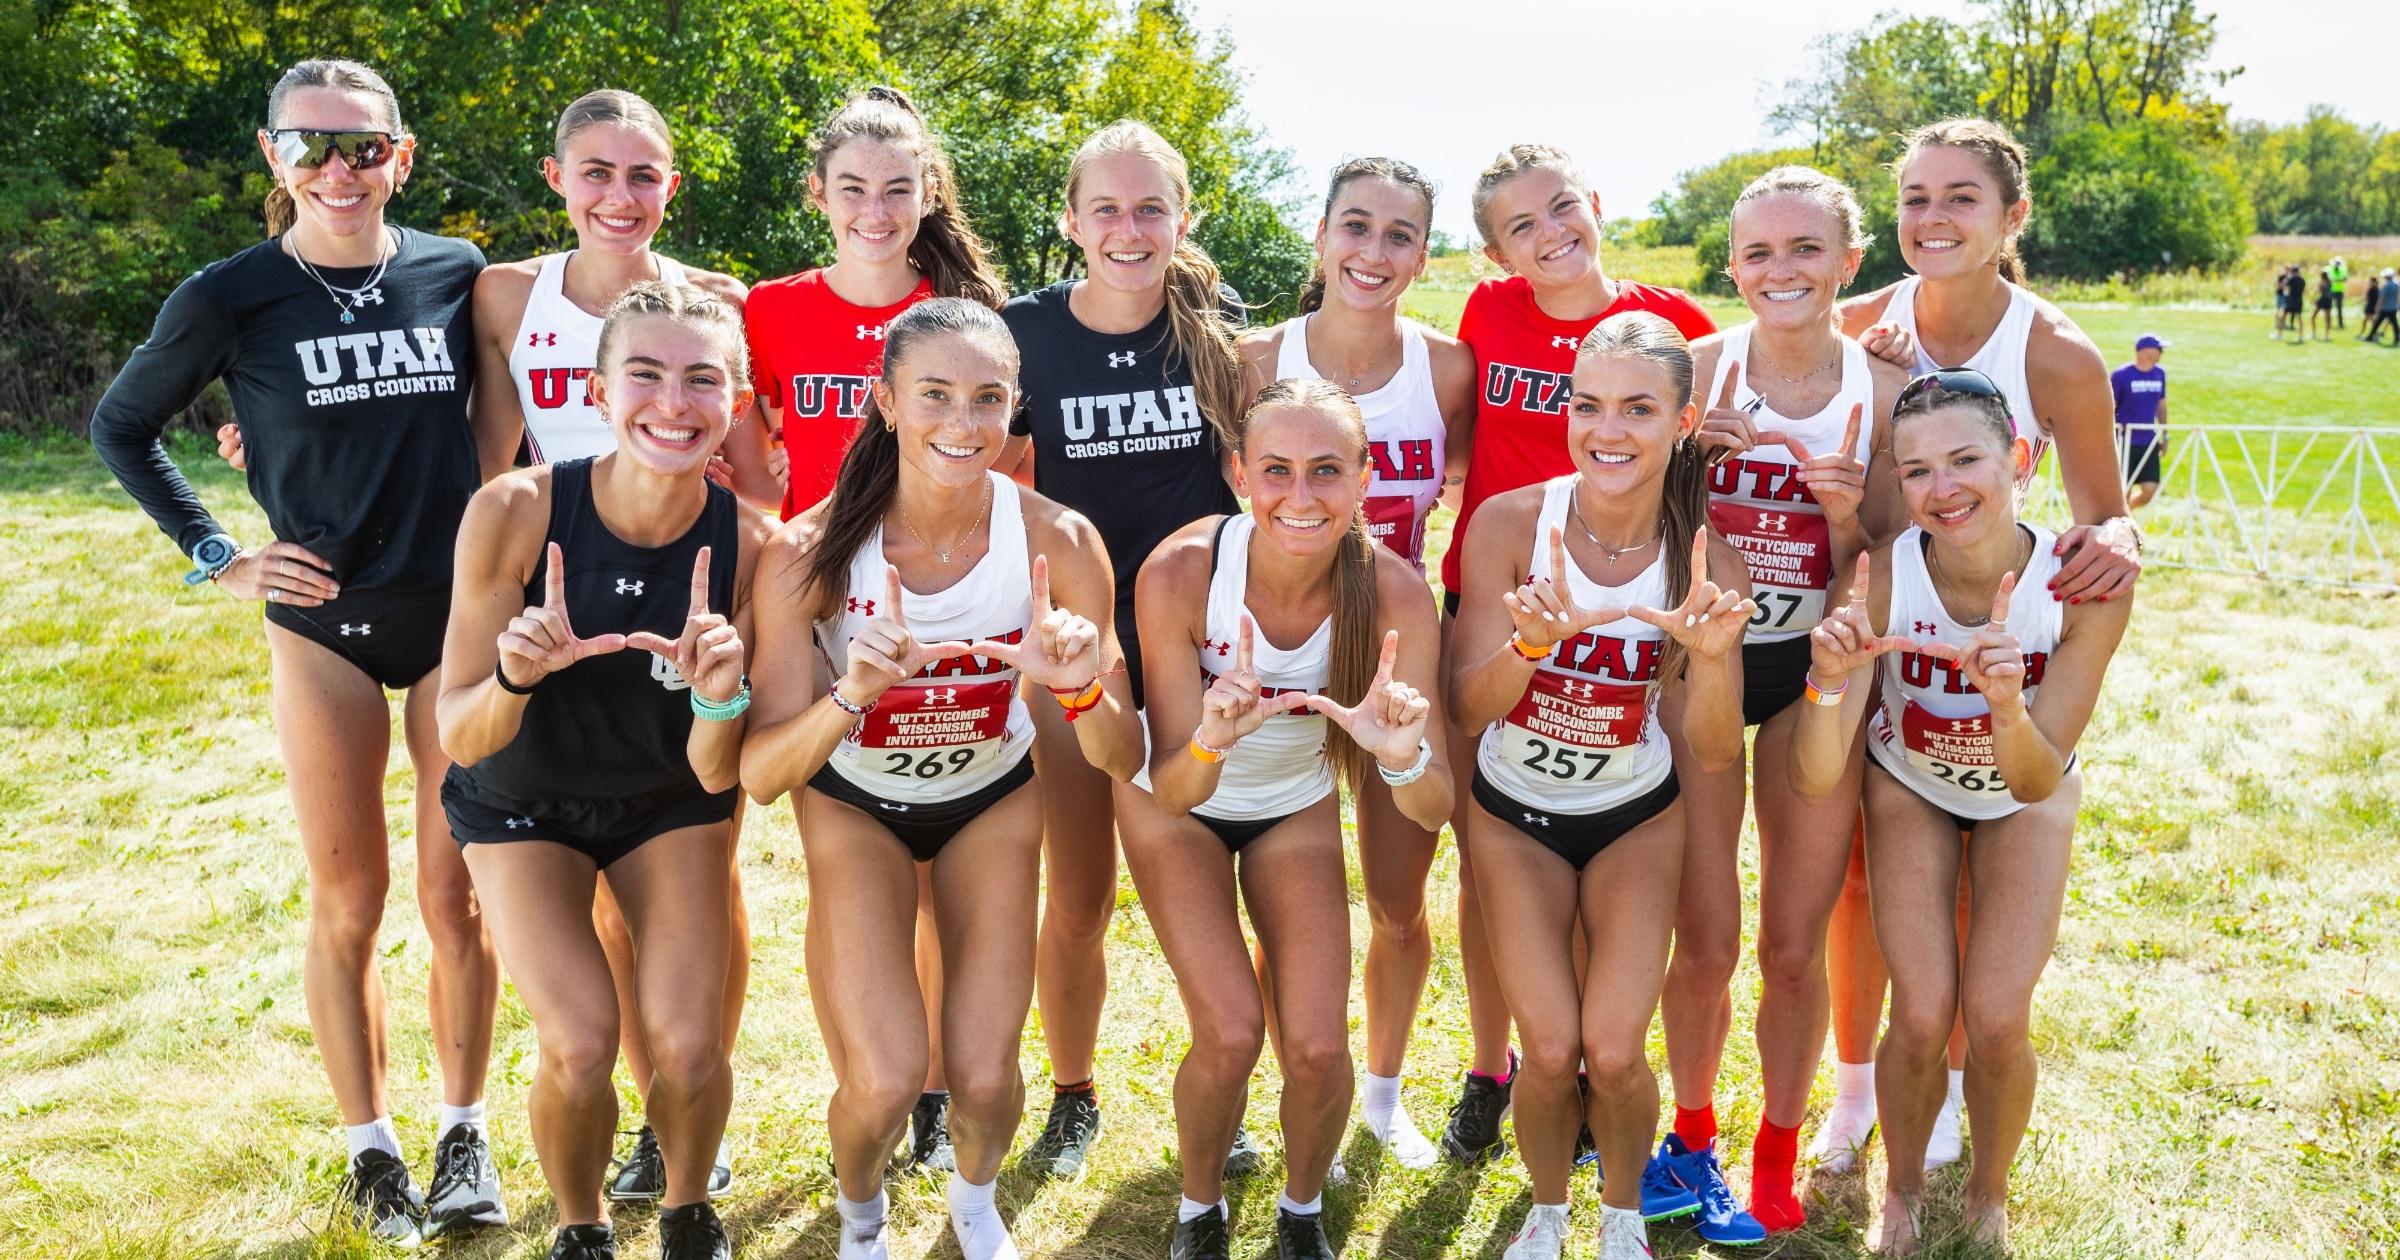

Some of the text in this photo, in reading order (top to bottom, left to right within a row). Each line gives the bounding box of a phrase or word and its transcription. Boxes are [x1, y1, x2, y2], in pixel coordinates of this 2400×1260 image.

[295, 327, 454, 386] UTAH
[306, 375, 456, 406] CROSS COUNTRY
[793, 374, 883, 418] UT
[1486, 362, 1573, 415] UTA
[1060, 385, 1202, 441] UTAH
[1065, 430, 1203, 459] CROSS COUNTRY
[1368, 439, 1435, 481] AH
[1708, 458, 1821, 505] UTA
[1726, 533, 1816, 557] NUTTYCOMBE
[1739, 550, 1802, 569] ISCONSIN
[1748, 566, 1812, 585] TATIONAL
[1750, 591, 1803, 628] 67
[1553, 631, 1666, 682] TAH
[1901, 651, 2049, 695] UTH
[890, 708, 990, 724] NUTTYCOMBE
[1532, 691, 1624, 720] NUTTYCOMBE
[1539, 707, 1610, 732] WISCONSIN
[885, 730, 986, 746] INVITATIONAL
[897, 721, 975, 735] WISCONSIN
[1527, 717, 1620, 745] INVITATIONAL
[1924, 730, 1992, 746] NUTTYCO
[1522, 738, 1612, 781] 257
[1924, 746, 1994, 765] INVITATIO
[1933, 741, 1993, 755] WISCONS
[882, 748, 976, 779] 269
[1930, 761, 2010, 792] 265
